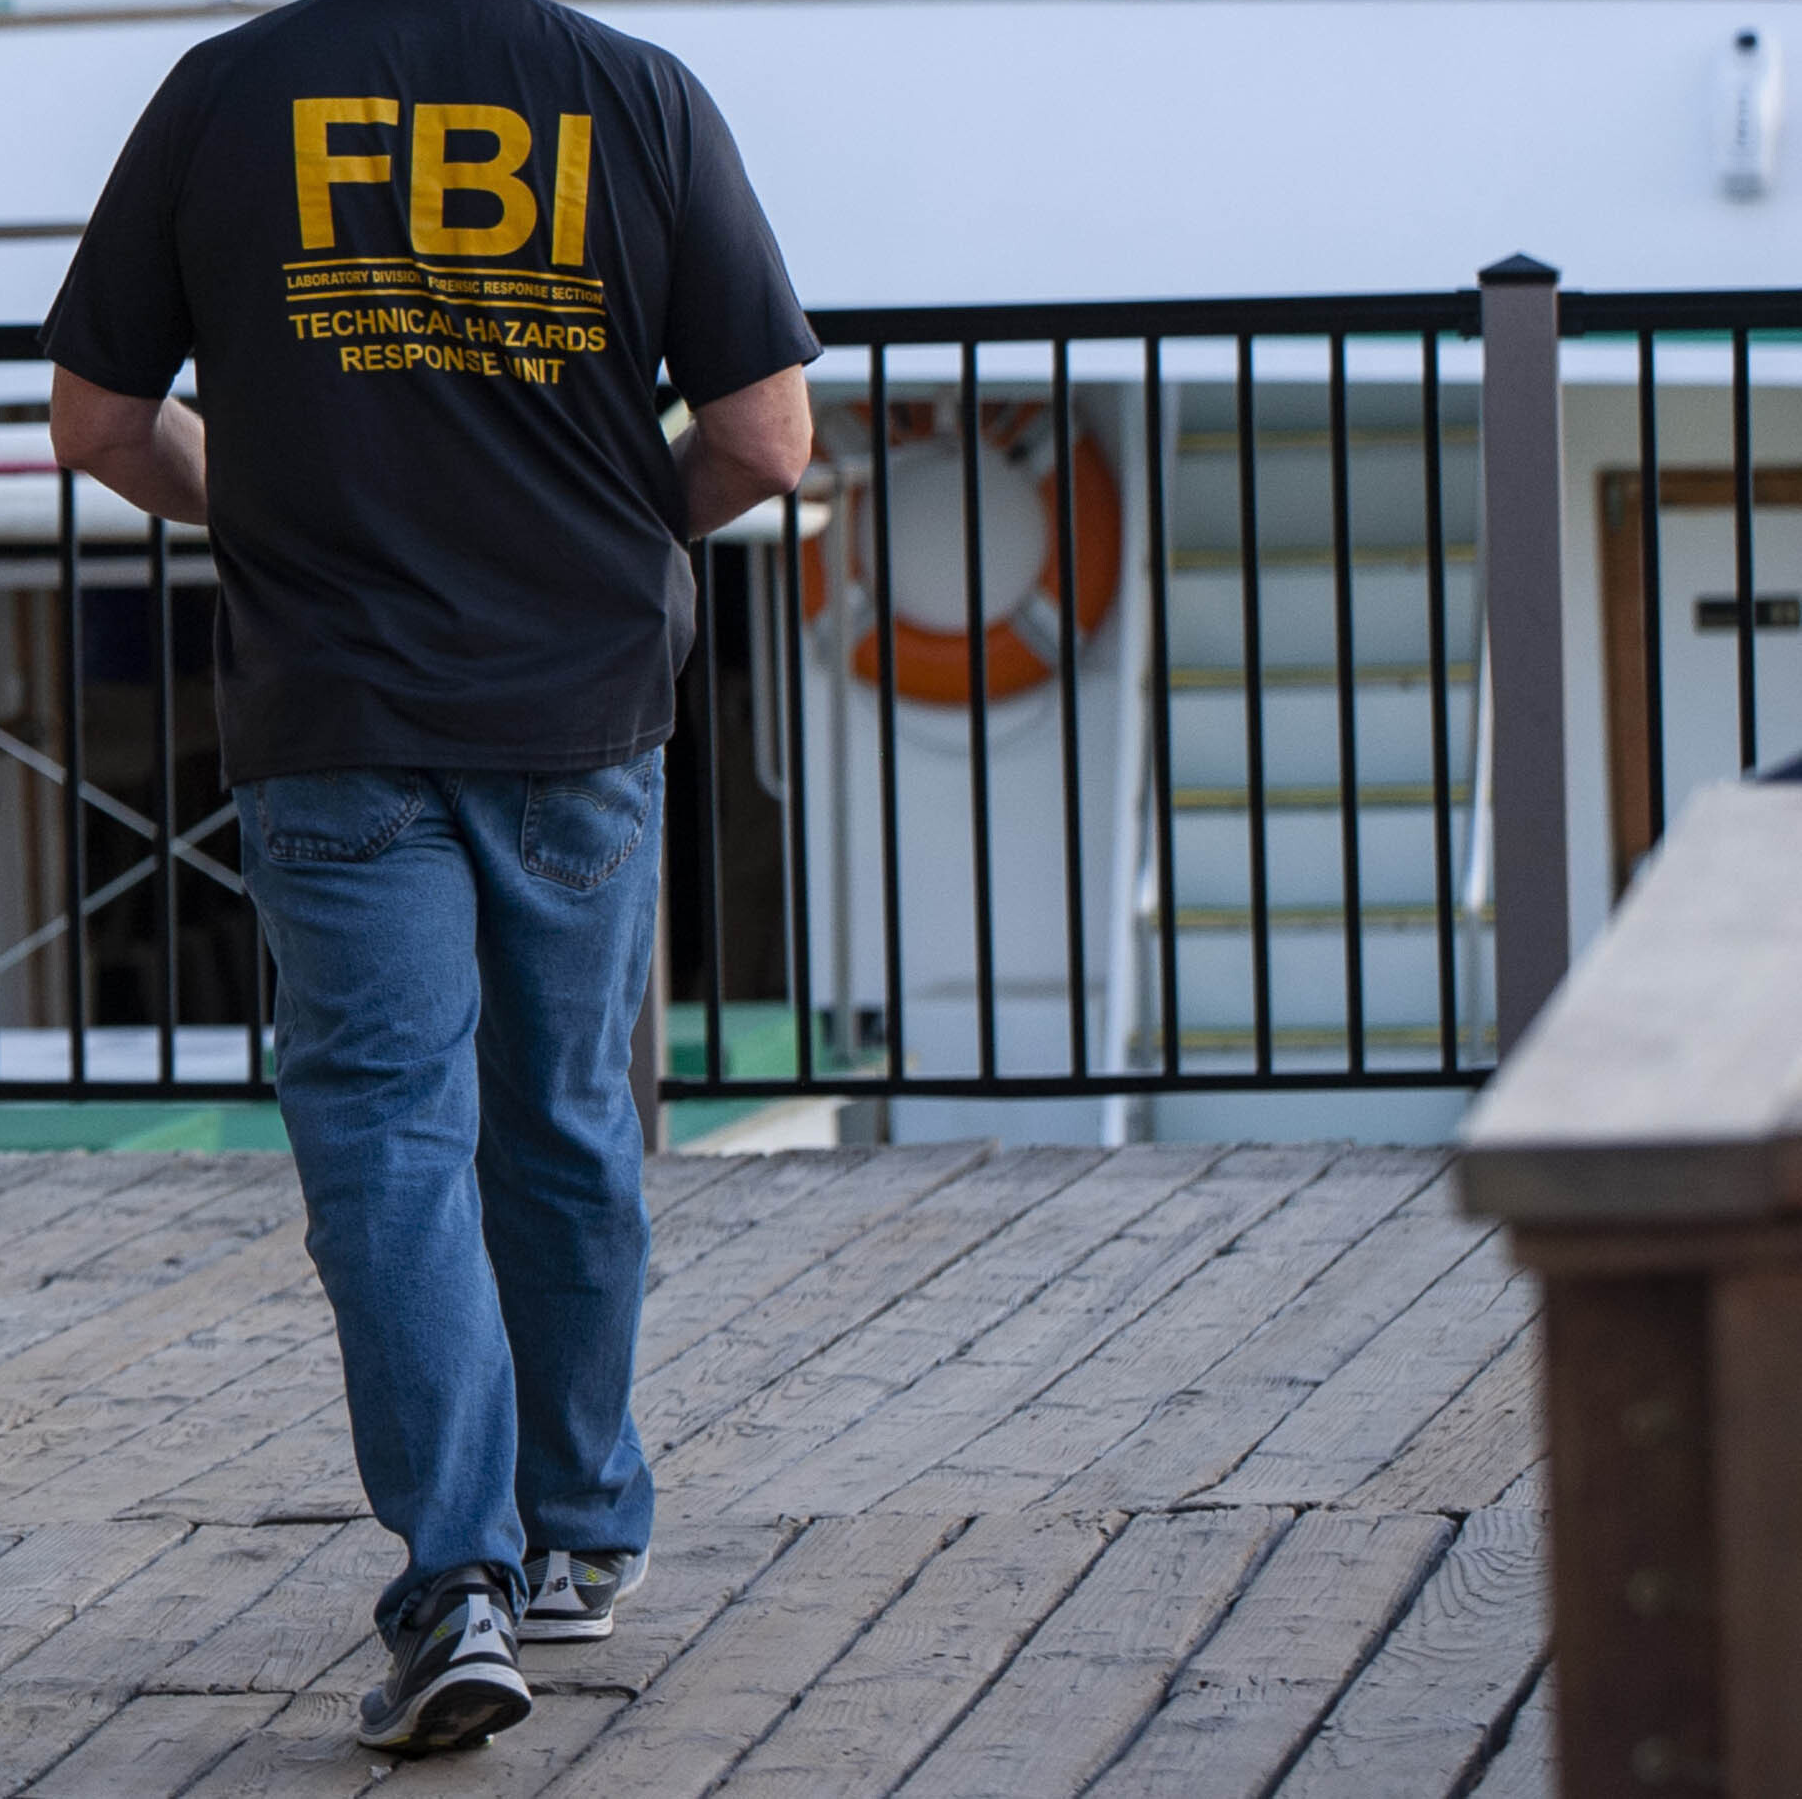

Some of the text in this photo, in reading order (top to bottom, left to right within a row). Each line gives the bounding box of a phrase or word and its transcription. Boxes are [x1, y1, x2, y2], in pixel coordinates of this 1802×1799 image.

[293, 96, 592, 266] FBI
[286, 269, 370, 289] LABORATORY
[483, 280, 549, 300] RESPONSE
[551, 285, 604, 305] SECTION
[289, 308, 607, 353] TECHNICAL HAZARDS
[340, 343, 502, 377] RESPONSE
